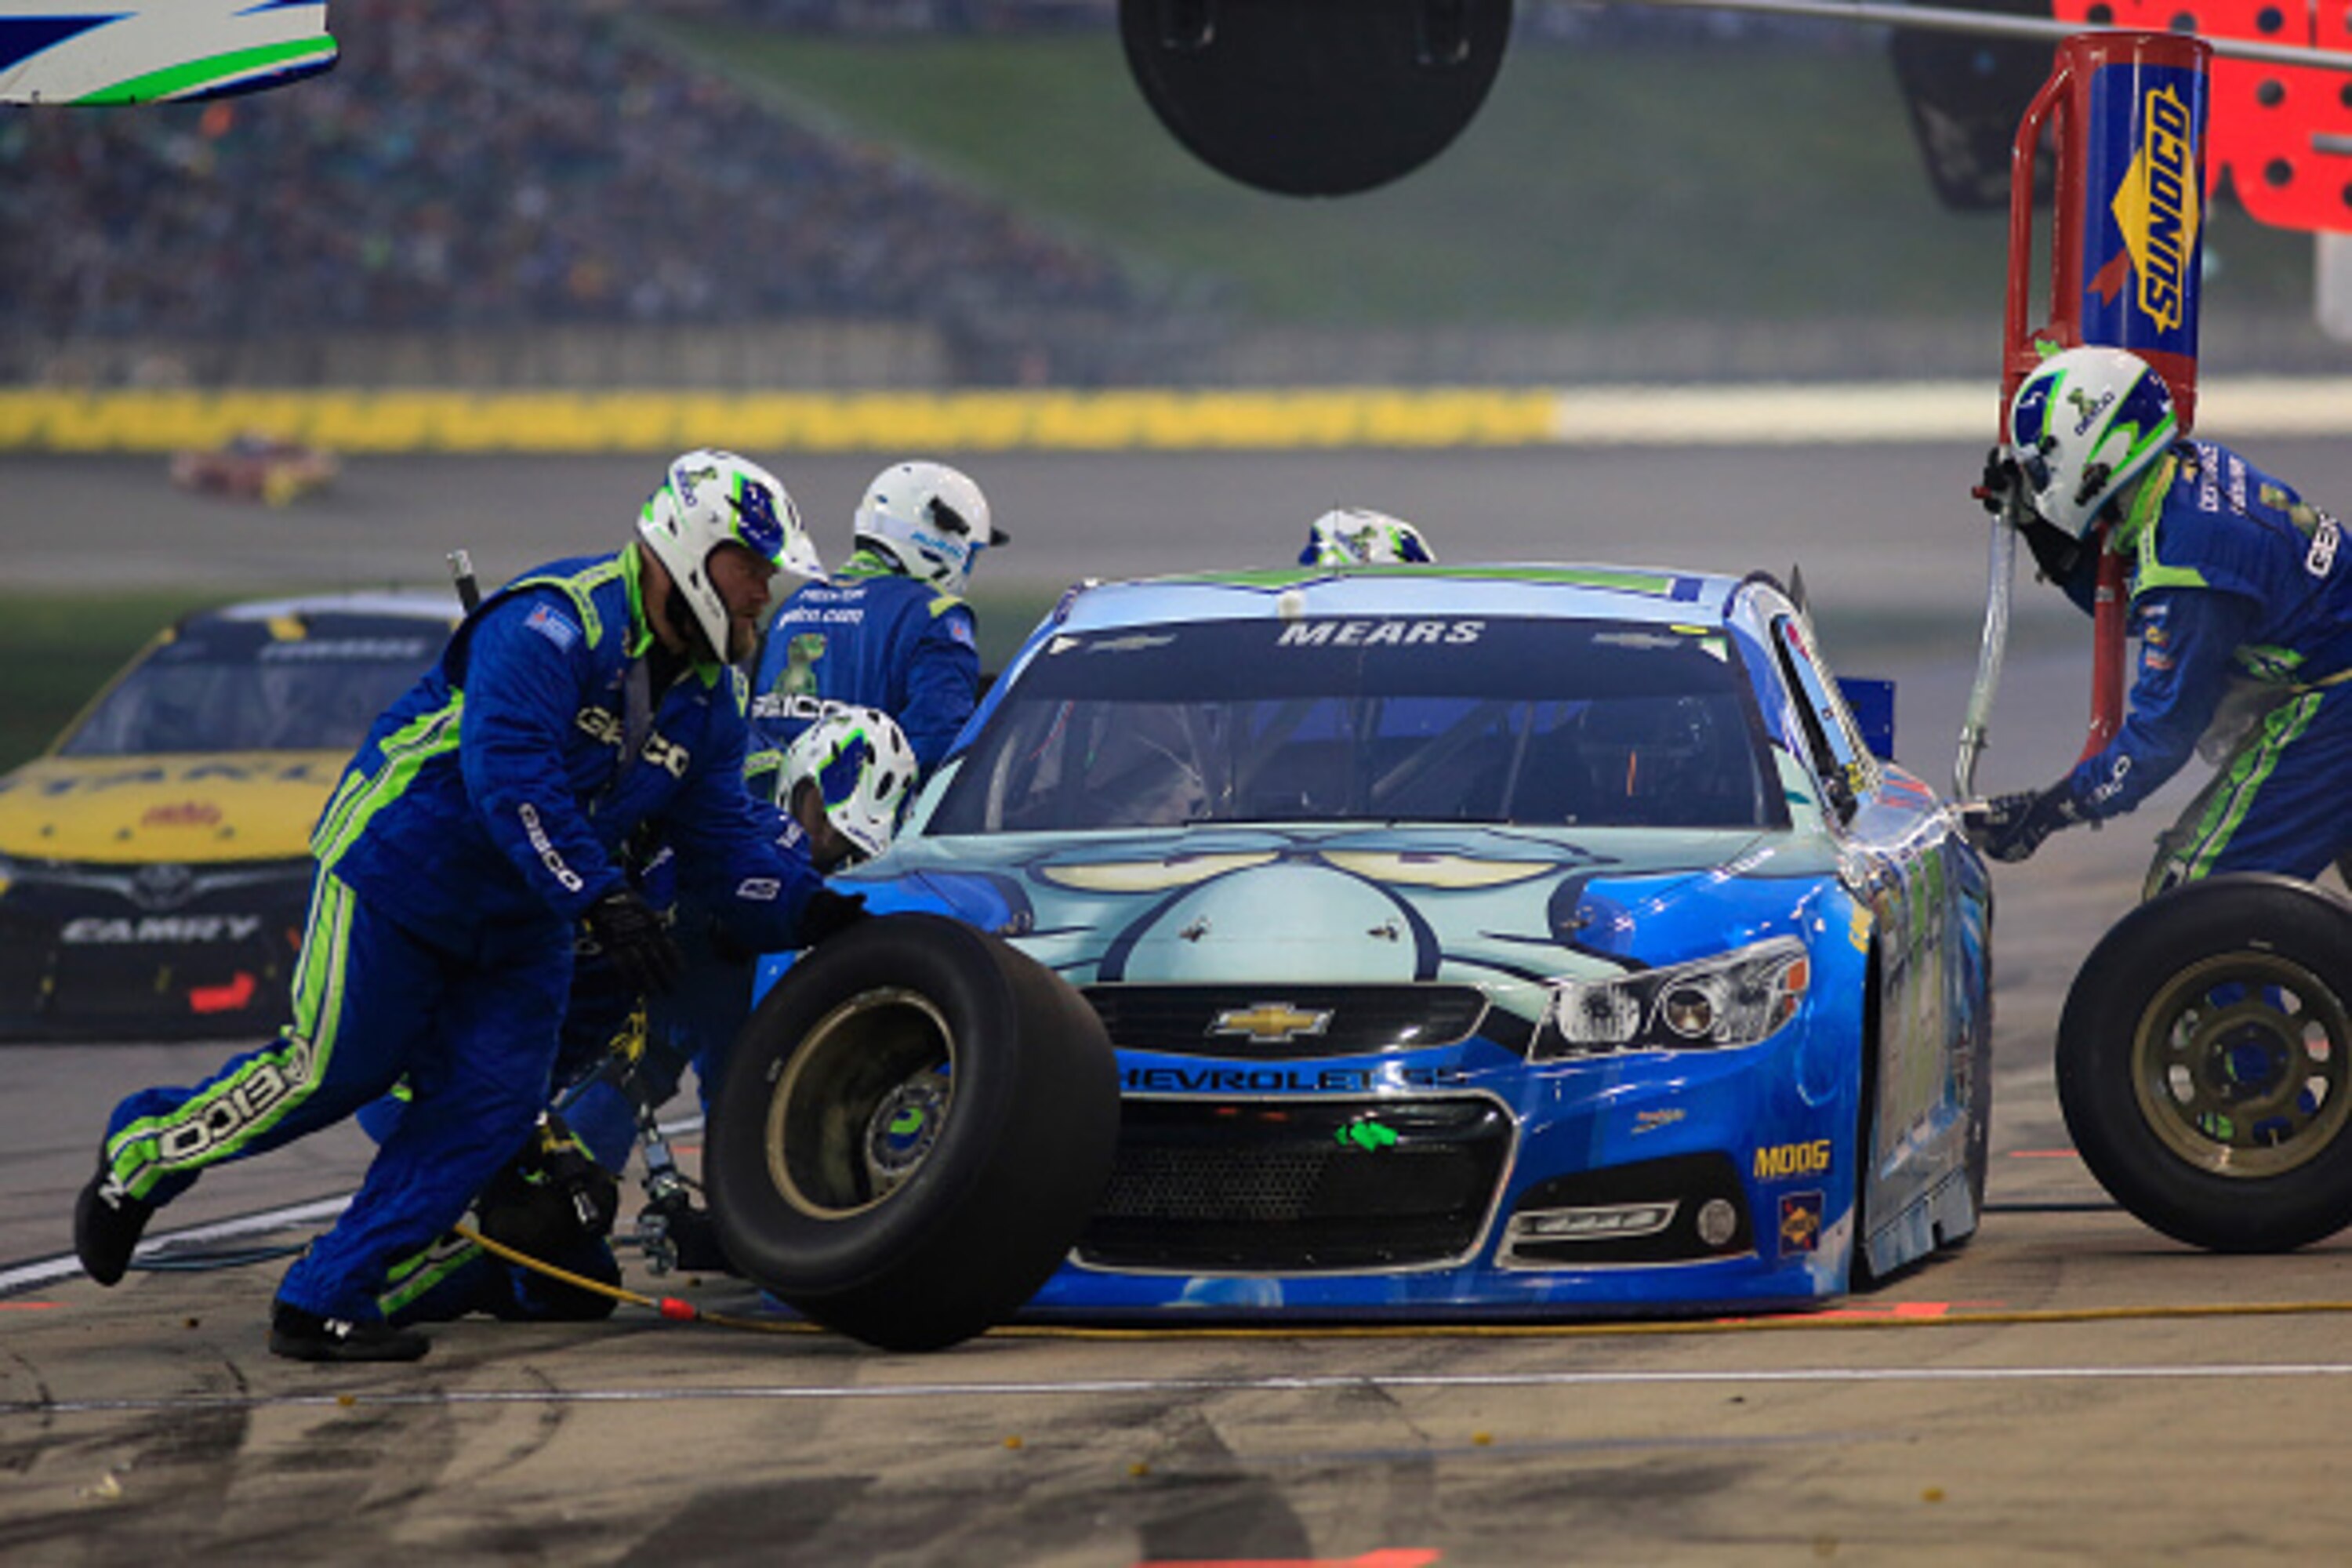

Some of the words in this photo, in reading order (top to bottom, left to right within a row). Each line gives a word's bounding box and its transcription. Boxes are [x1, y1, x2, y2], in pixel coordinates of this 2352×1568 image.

[2145, 95, 2187, 326] SUNOCO
[1276, 621, 1486, 646] MEARS
[517, 802, 584, 892] GEICO
[61, 915, 261, 942] CAMRY
[1120, 1069, 1374, 1091] HEVROLET
[1753, 1139, 1831, 1178] MOOG
